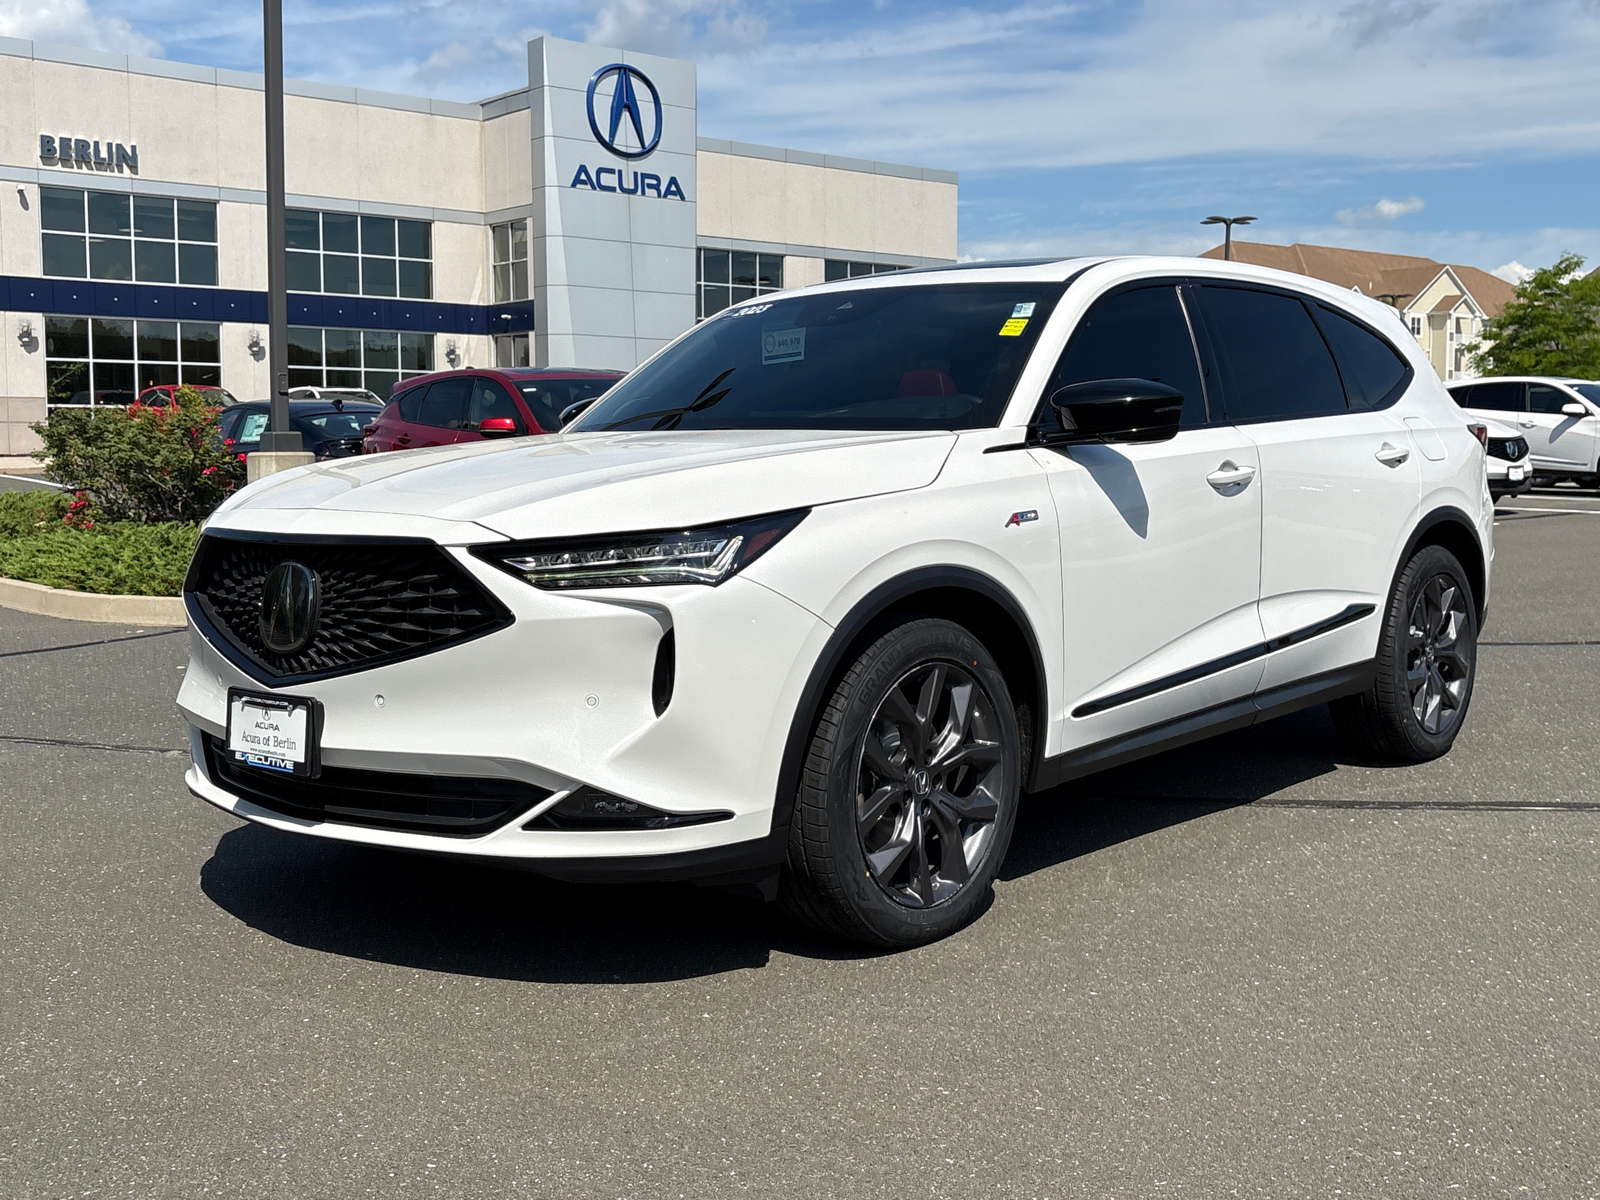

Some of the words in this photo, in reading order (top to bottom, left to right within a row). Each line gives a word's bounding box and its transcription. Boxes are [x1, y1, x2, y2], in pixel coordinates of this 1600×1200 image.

[40, 134, 139, 170] BERLIN
[570, 164, 686, 201] ACURA
[255, 721, 280, 732] ACURA
[242, 730, 261, 744] Acura
[262, 735, 271, 747] of
[273, 735, 296, 750] Berlin
[235, 751, 294, 770] EXECUTIVE
